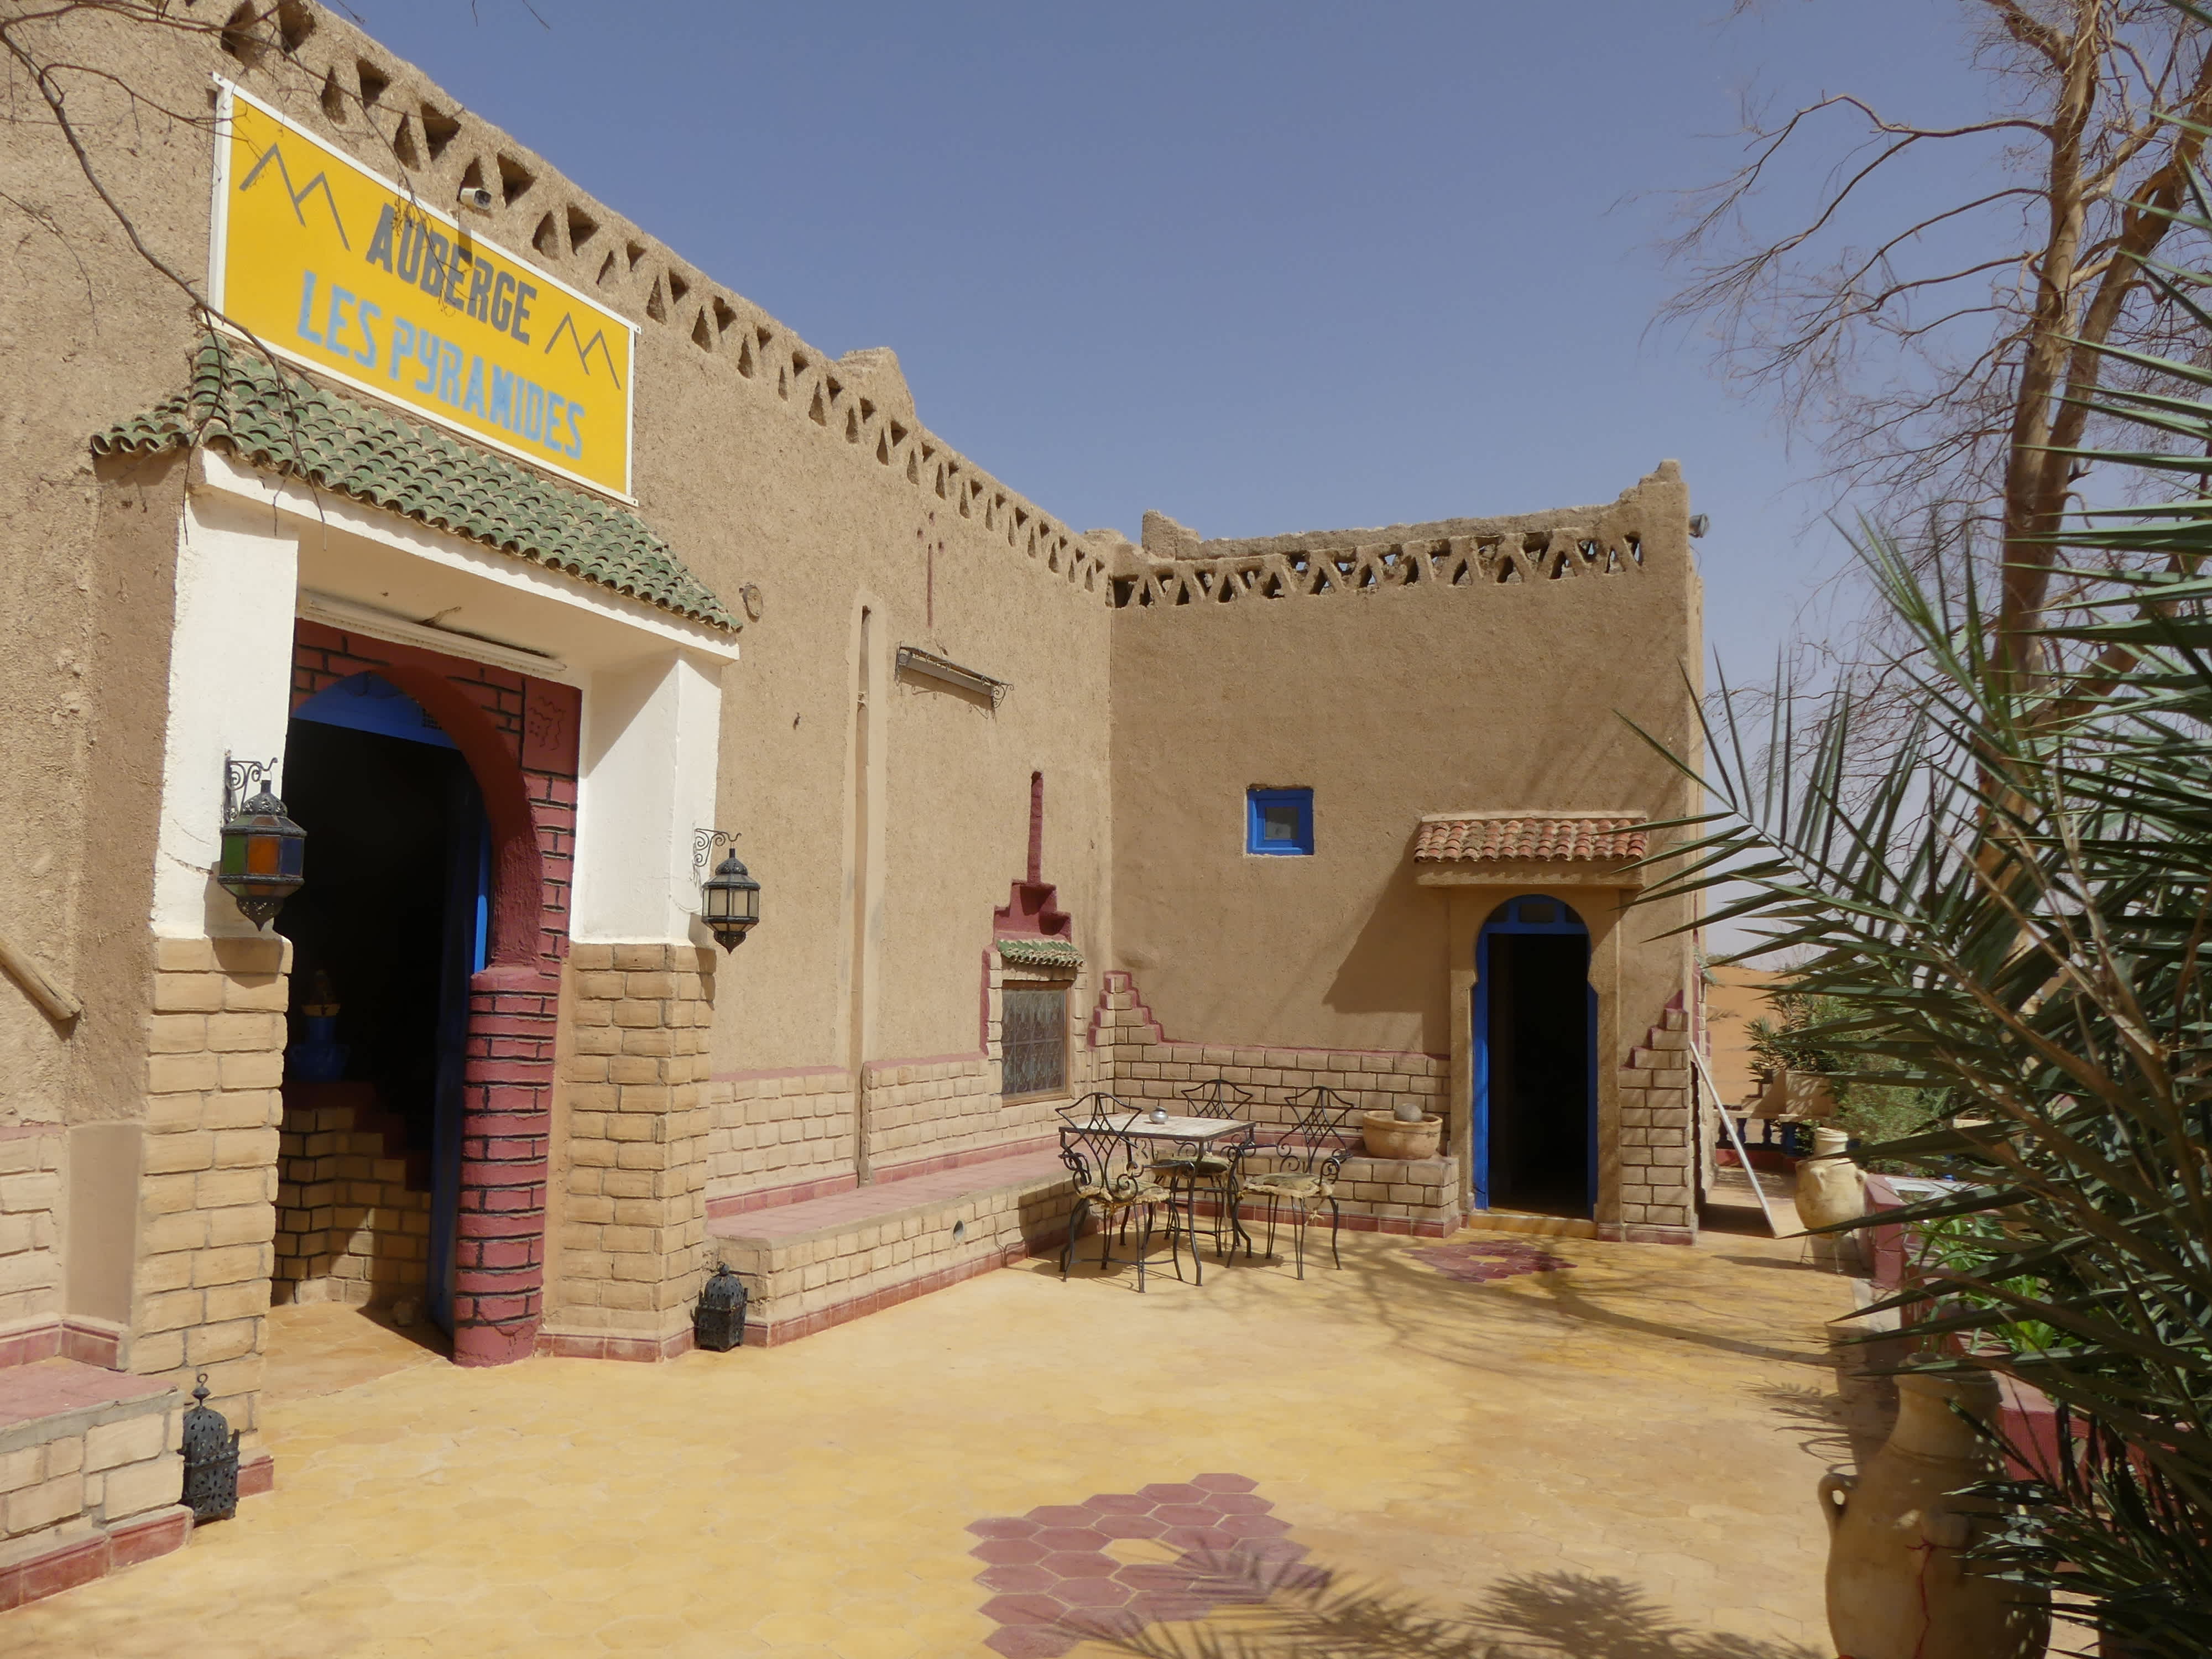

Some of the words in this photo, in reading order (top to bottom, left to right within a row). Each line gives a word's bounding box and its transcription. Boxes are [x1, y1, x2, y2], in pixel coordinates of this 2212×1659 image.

[366, 202, 537, 346] AUBERGE
[297, 268, 382, 370] LES
[389, 316, 586, 460] PYRAMIDES
